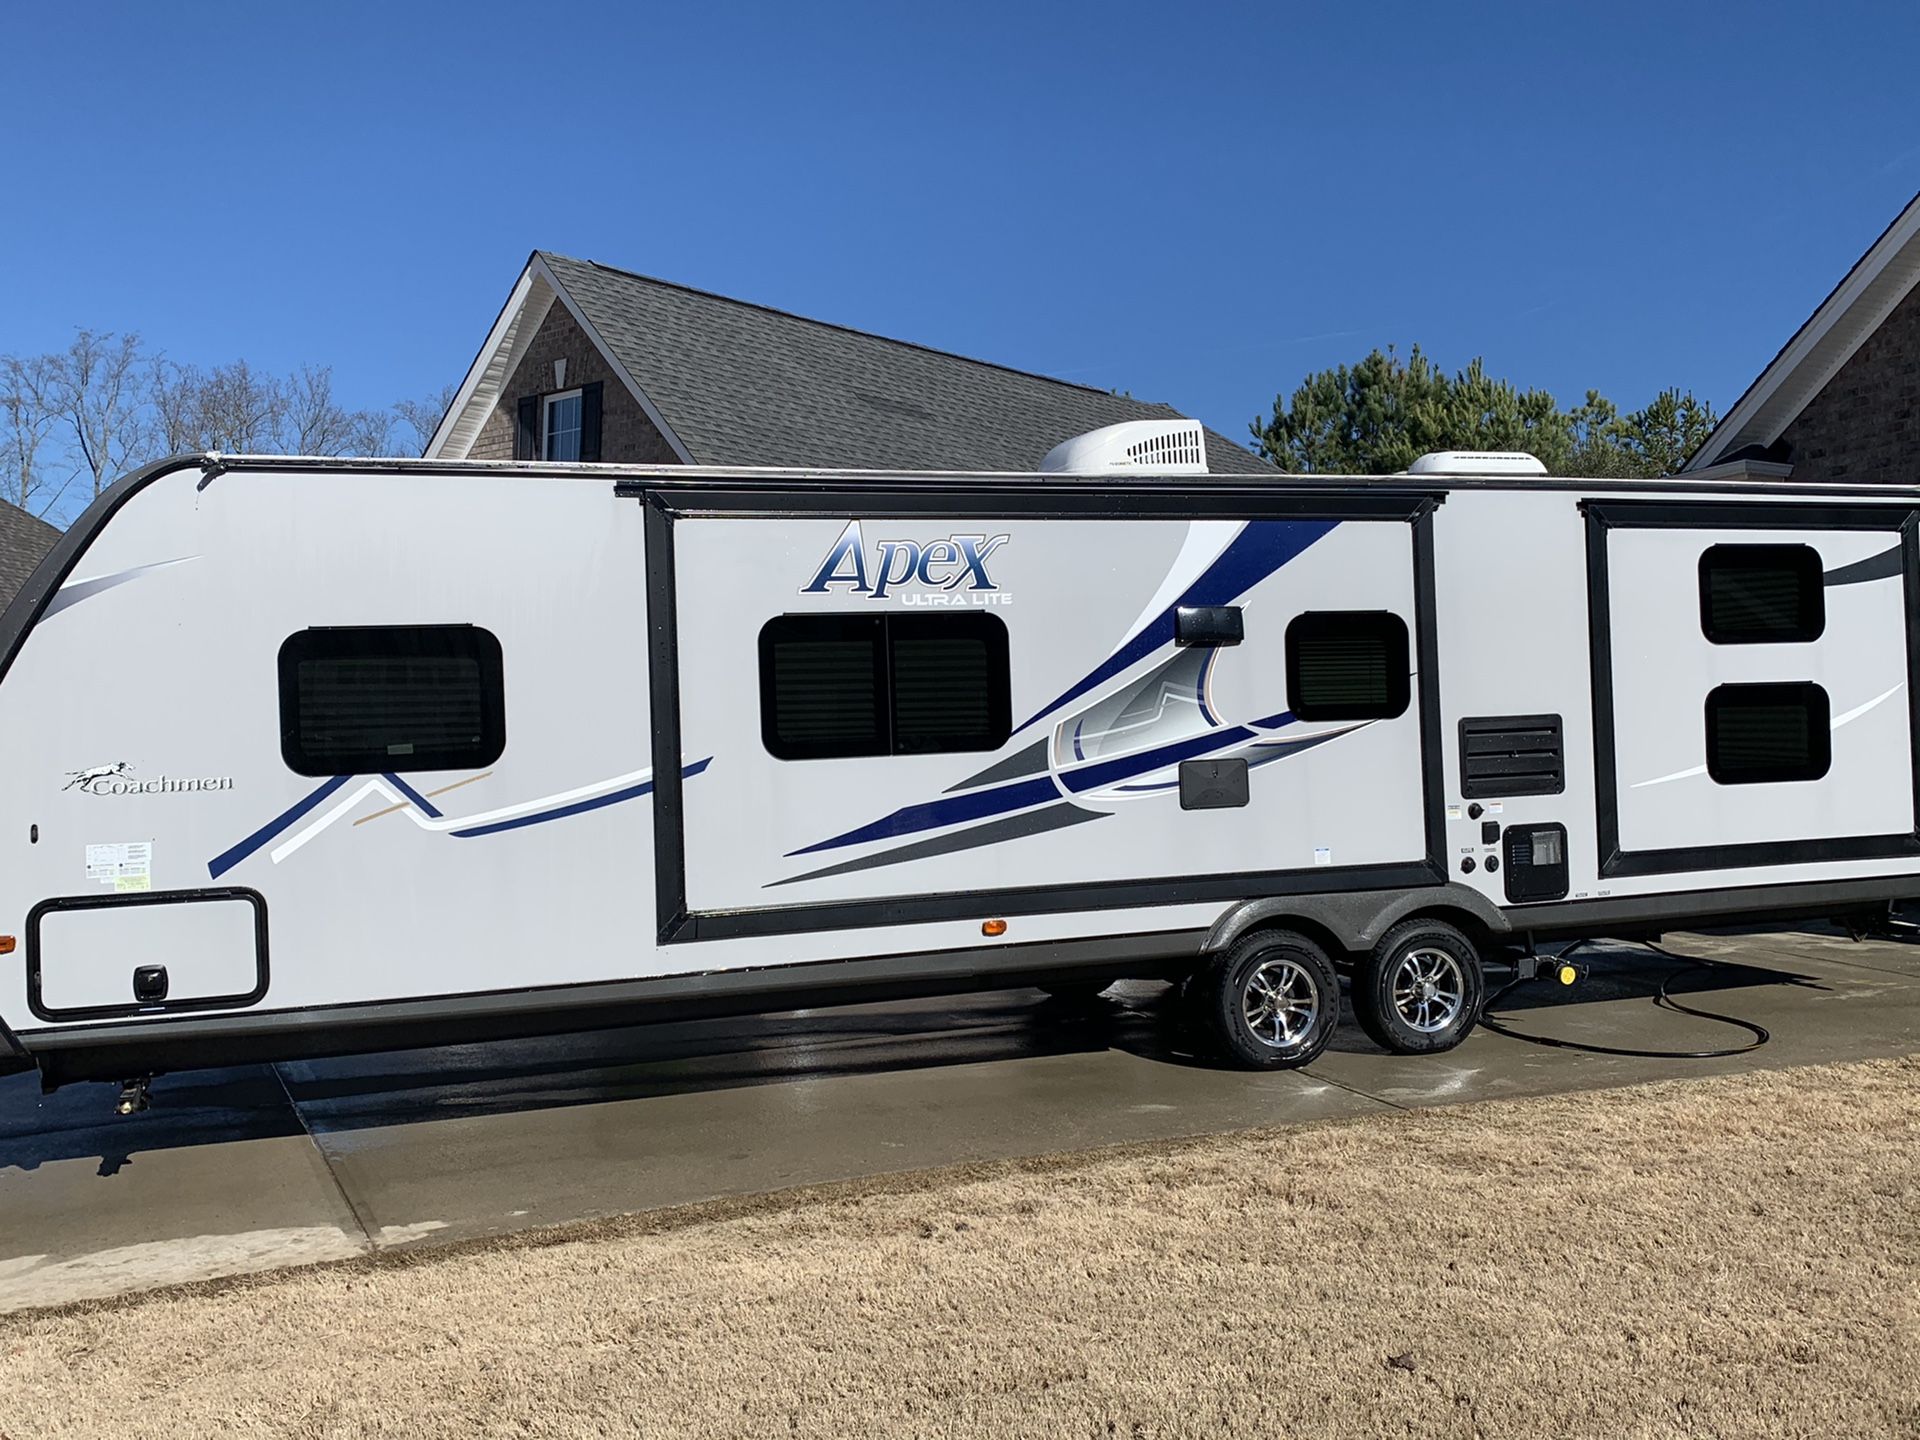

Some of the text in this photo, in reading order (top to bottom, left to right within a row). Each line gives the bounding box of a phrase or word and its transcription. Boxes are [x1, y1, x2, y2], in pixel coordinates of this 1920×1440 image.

[902, 593, 1012, 606] ULTRA LITE
[90, 775, 234, 795] Coachmen
